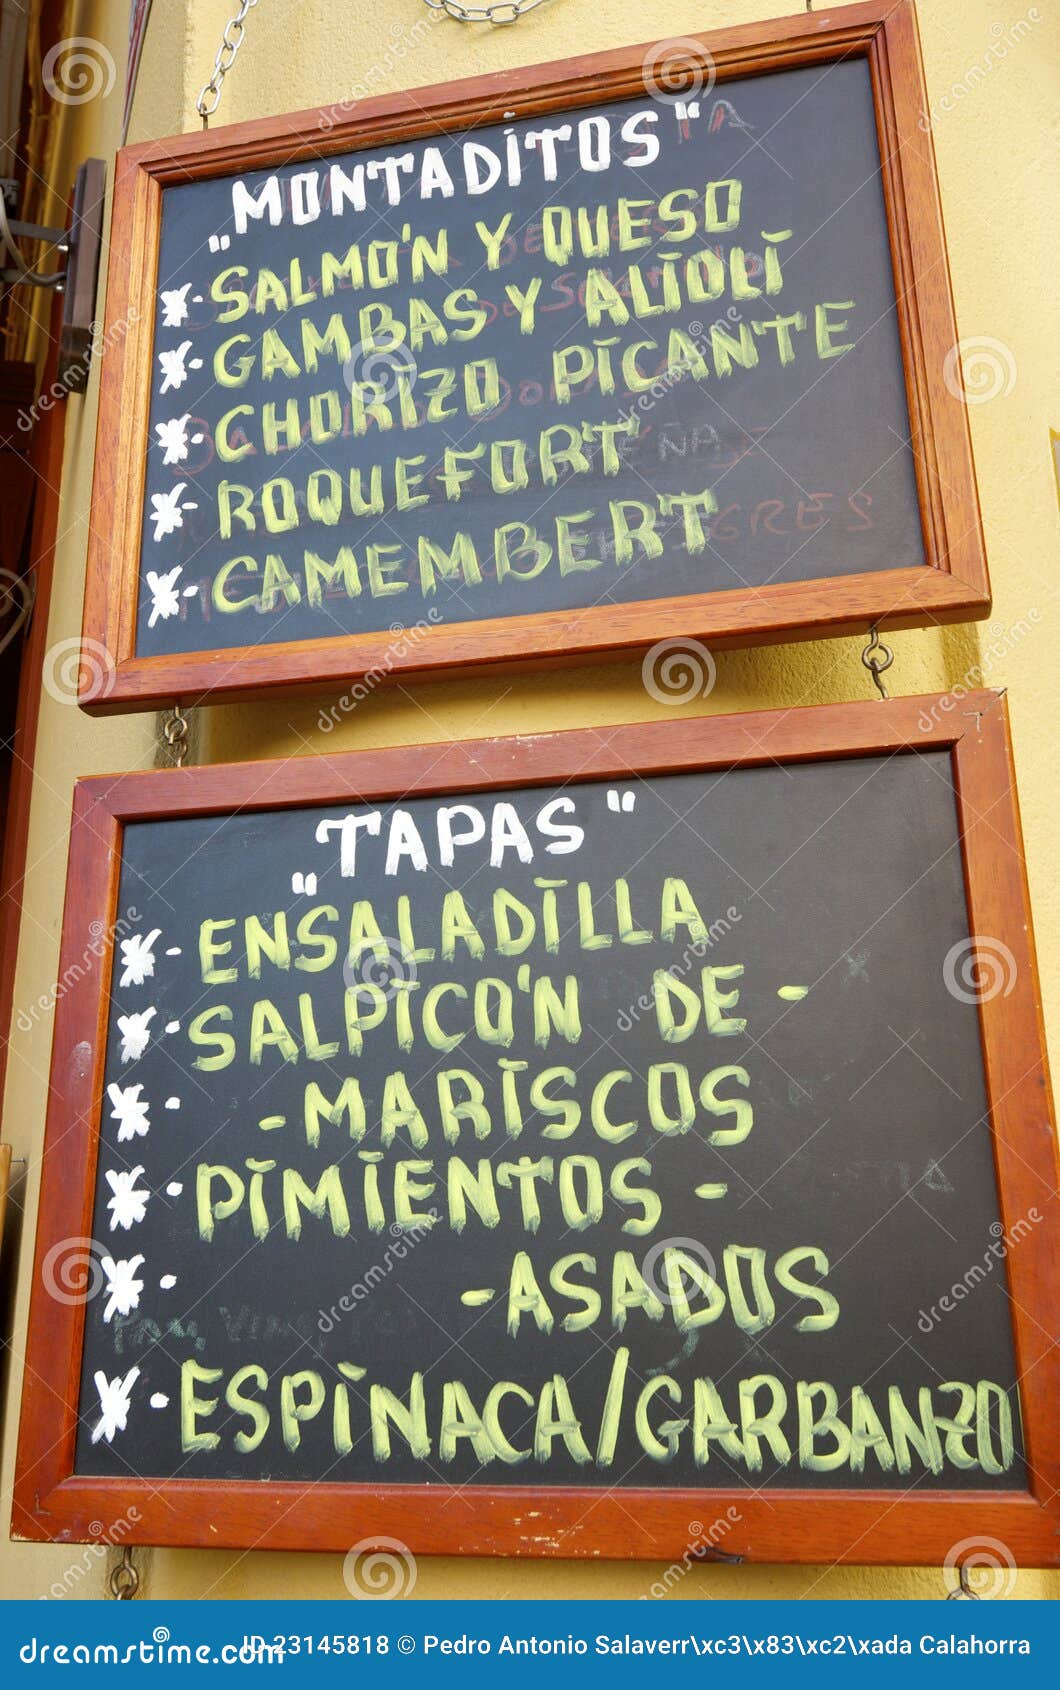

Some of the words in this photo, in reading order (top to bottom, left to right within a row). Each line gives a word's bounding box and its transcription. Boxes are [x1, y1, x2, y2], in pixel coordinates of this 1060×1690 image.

[475, 212, 512, 271] Y
[542, 179, 742, 266] QUESO
[213, 288, 488, 388] GAMBAS
[504, 277, 542, 335] Y
[215, 358, 502, 462] CHORIZO
[552, 300, 856, 404] PICANTE
[217, 417, 640, 540] ROQUEFORT
[212, 488, 719, 613] CAMEMBERT
[199, 877, 709, 985] ENSALADILLA
[653, 963, 748, 1043] DE
[196, 1151, 662, 1242] PIMIENTOS
